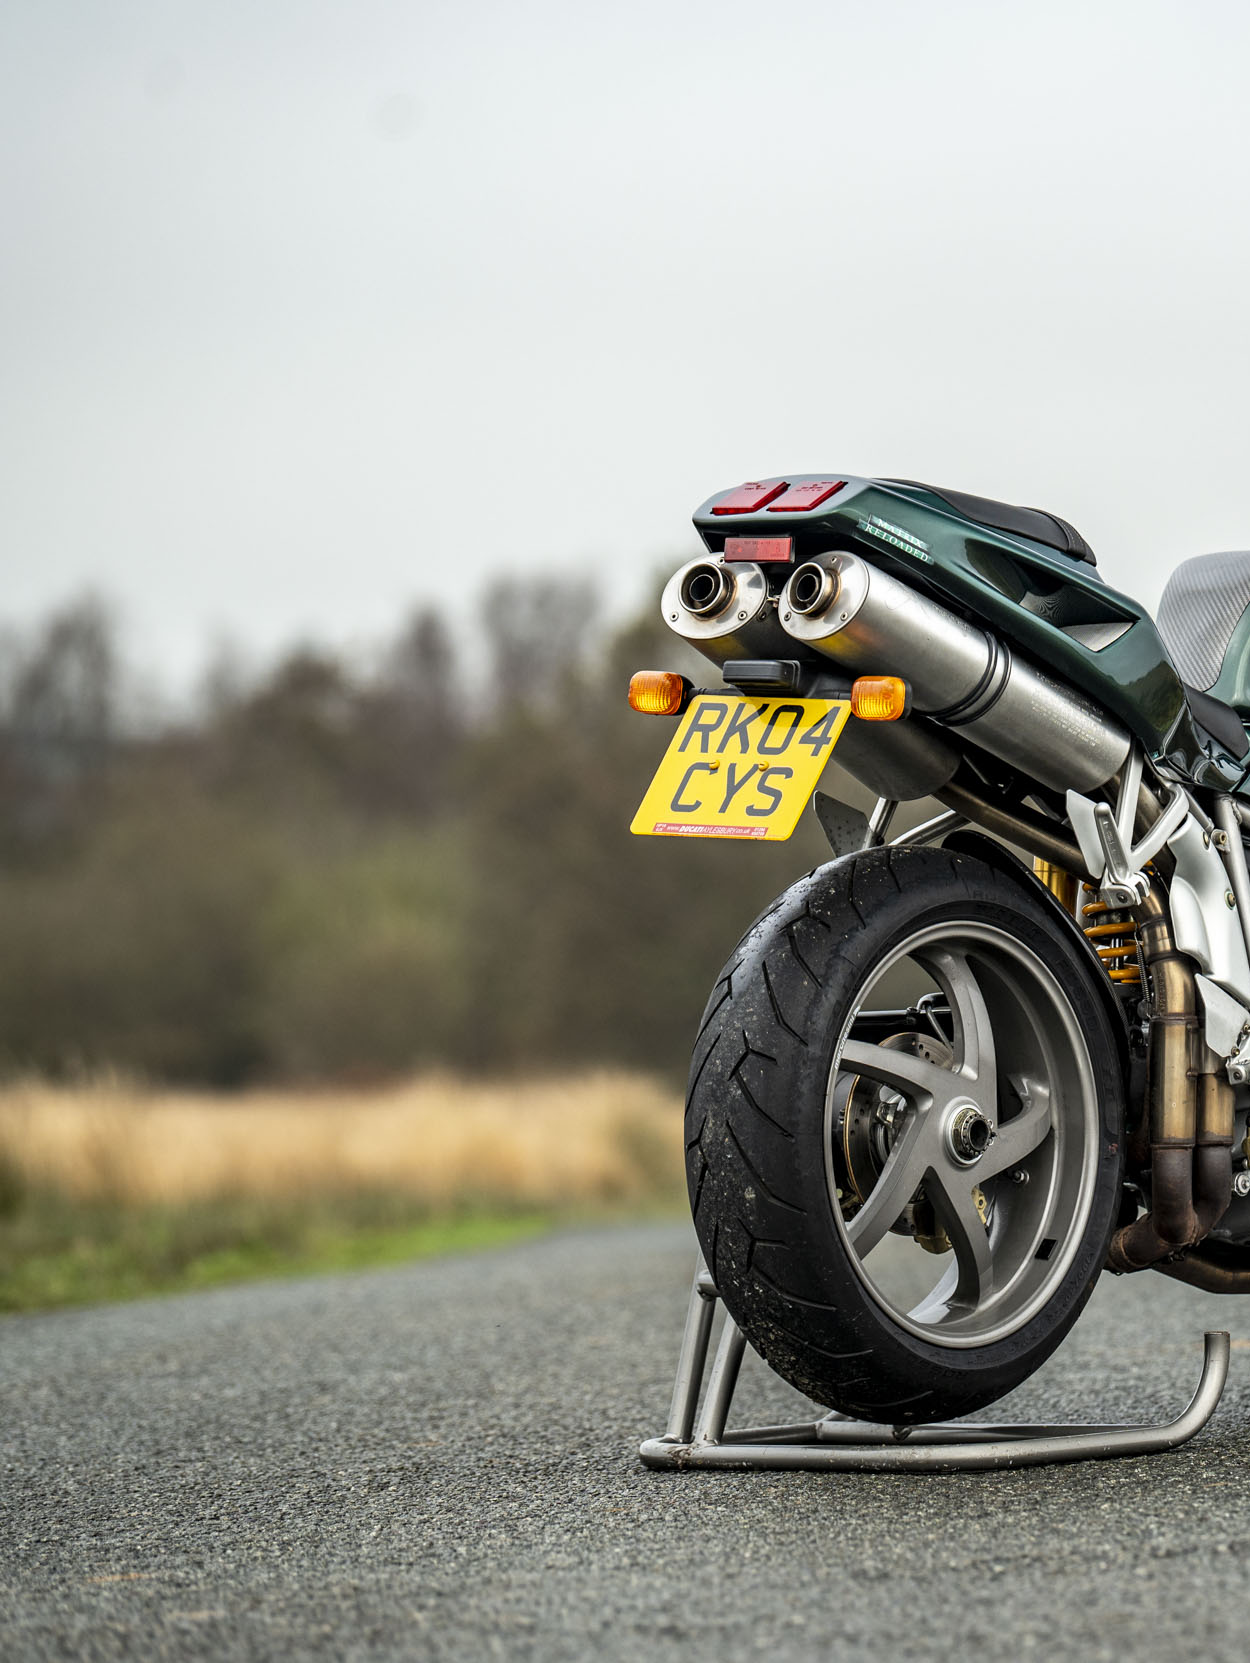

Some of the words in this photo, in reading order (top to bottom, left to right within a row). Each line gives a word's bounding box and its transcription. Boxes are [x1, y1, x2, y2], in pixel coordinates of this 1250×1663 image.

[864, 523, 929, 562] RELOADED
[878, 518, 923, 548] MATRIX
[677, 702, 842, 757] RK04
[670, 761, 794, 817] CYS
